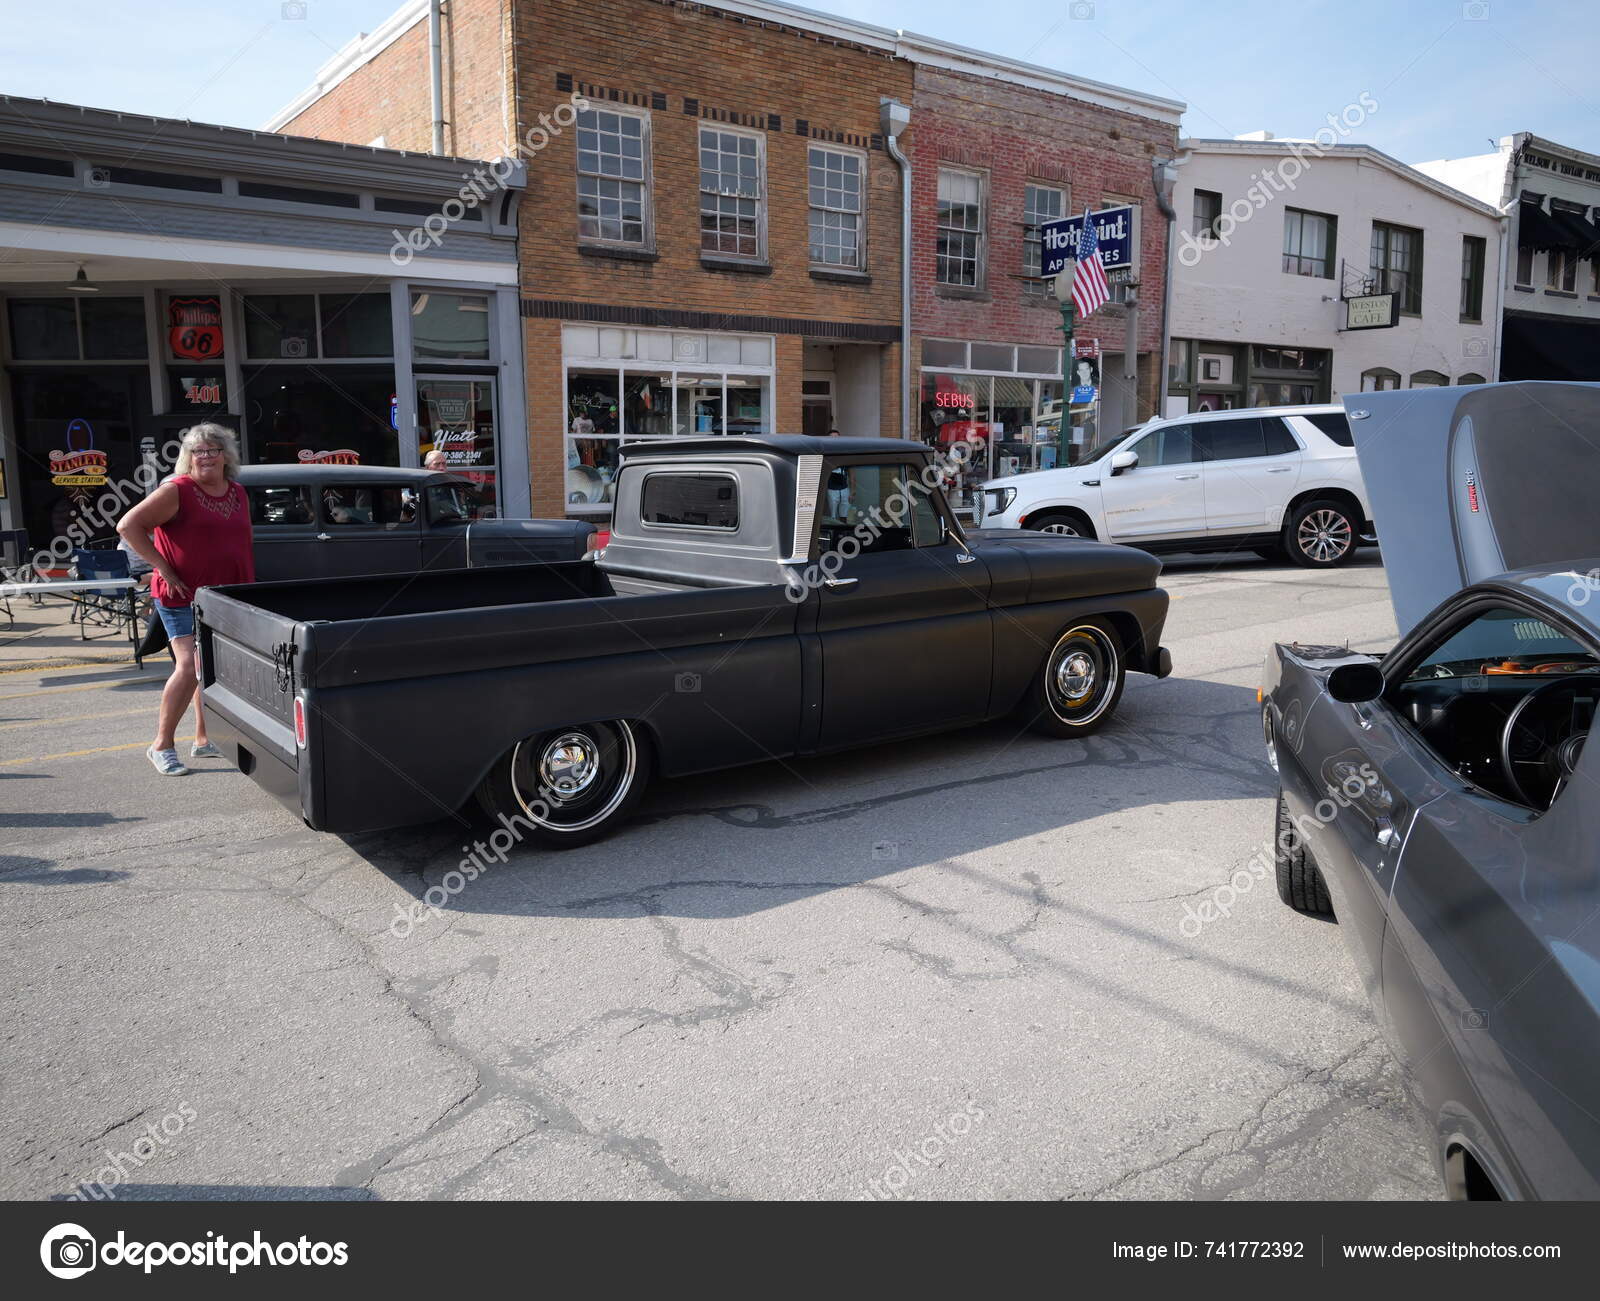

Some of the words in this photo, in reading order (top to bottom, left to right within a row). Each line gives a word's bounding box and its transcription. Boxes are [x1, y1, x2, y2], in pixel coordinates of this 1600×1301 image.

[1043, 215, 1127, 254] Hotint
[174, 304, 219, 326] Phillips
[1351, 300, 1390, 310] WESTON
[182, 328, 213, 354] 66
[185, 384, 221, 404] 401
[936, 392, 975, 409] SEBUS
[433, 429, 479, 452] Hiatt
[50, 454, 107, 473] STANLEY'S
